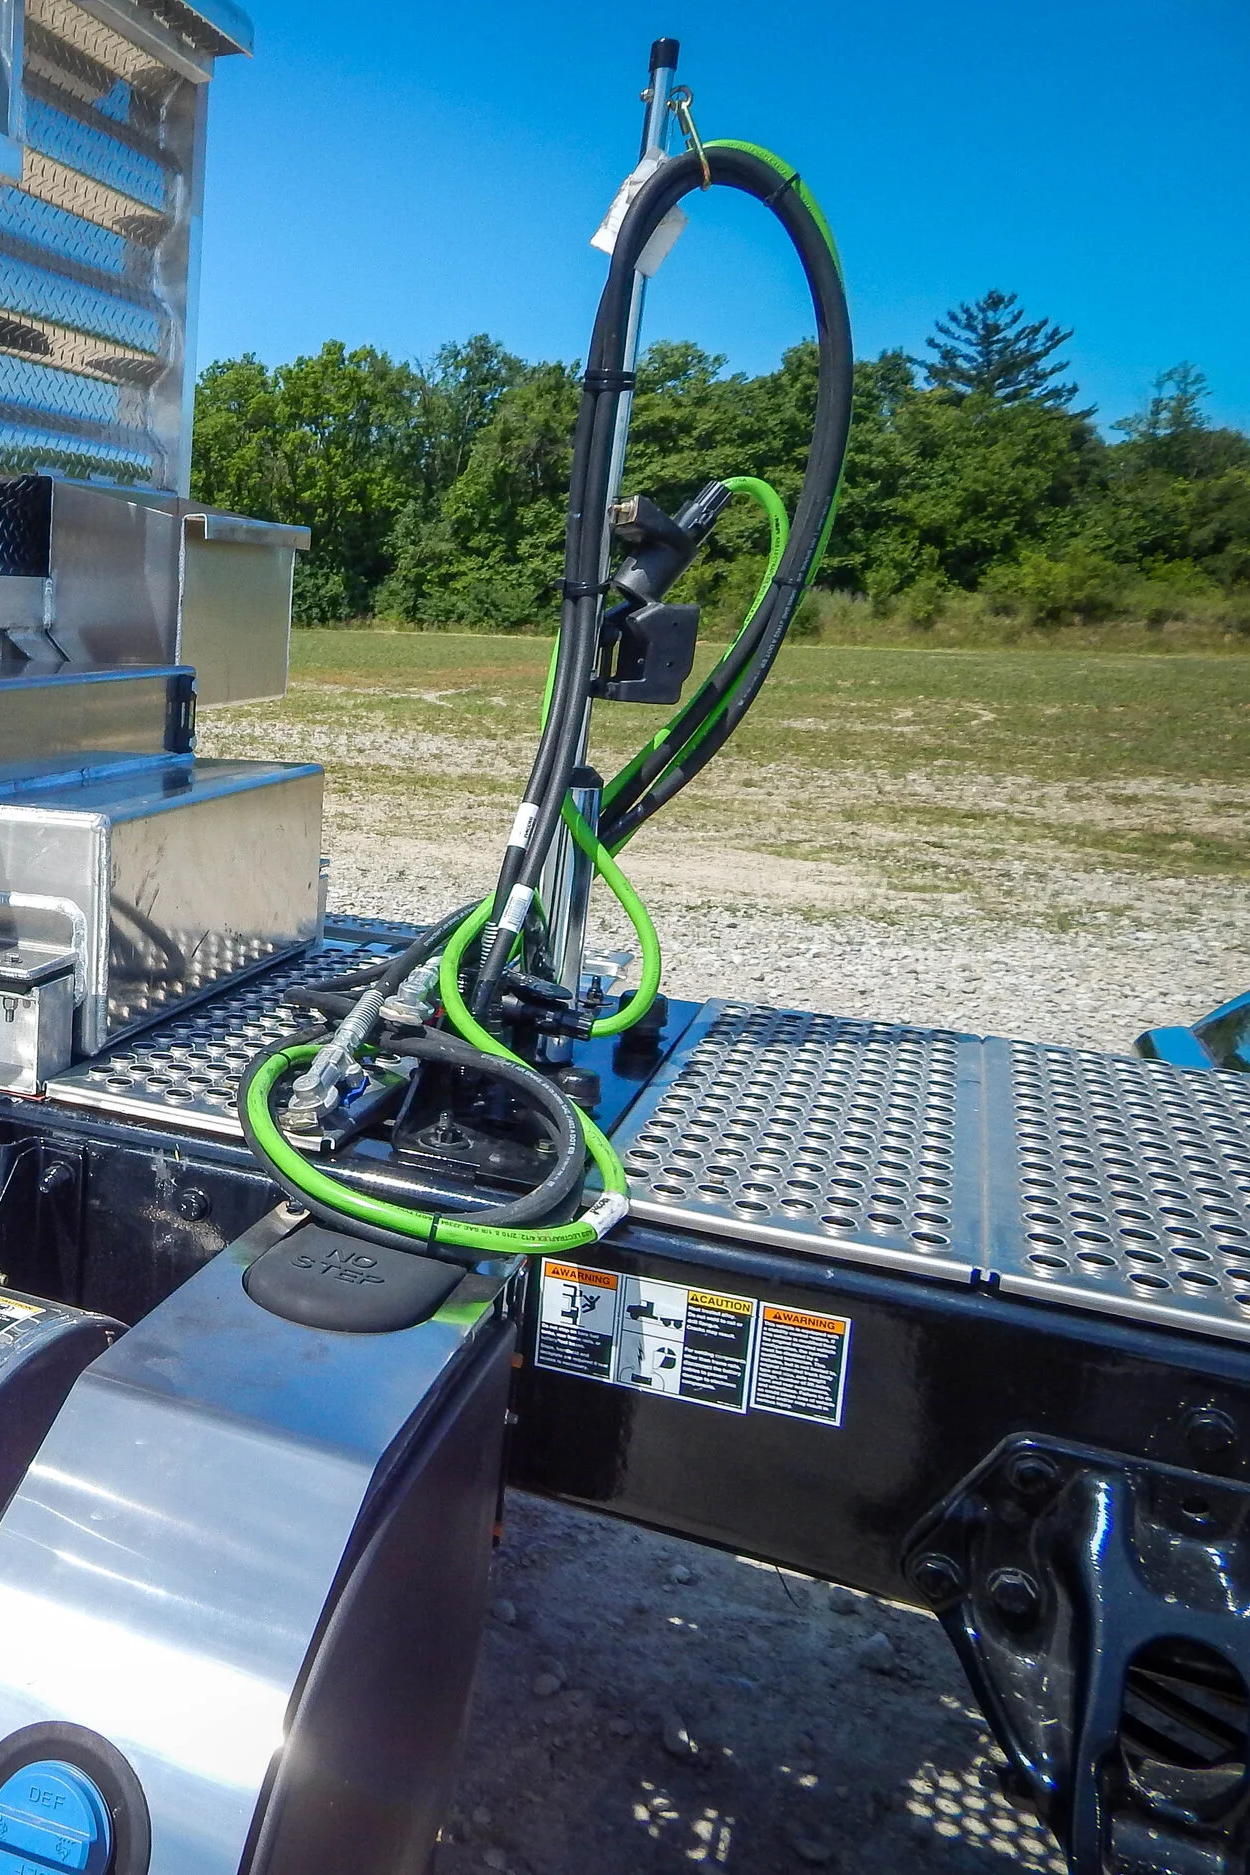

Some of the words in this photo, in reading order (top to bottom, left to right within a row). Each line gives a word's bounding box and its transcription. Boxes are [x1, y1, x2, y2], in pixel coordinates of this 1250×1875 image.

[326, 1249, 377, 1268] NO
[291, 1256, 386, 1285] STEP
[559, 1267, 611, 1286] WARNING
[699, 1293, 751, 1312] CAUTION
[781, 1310, 836, 1330] WARNING
[29, 1787, 66, 1809] DEF
